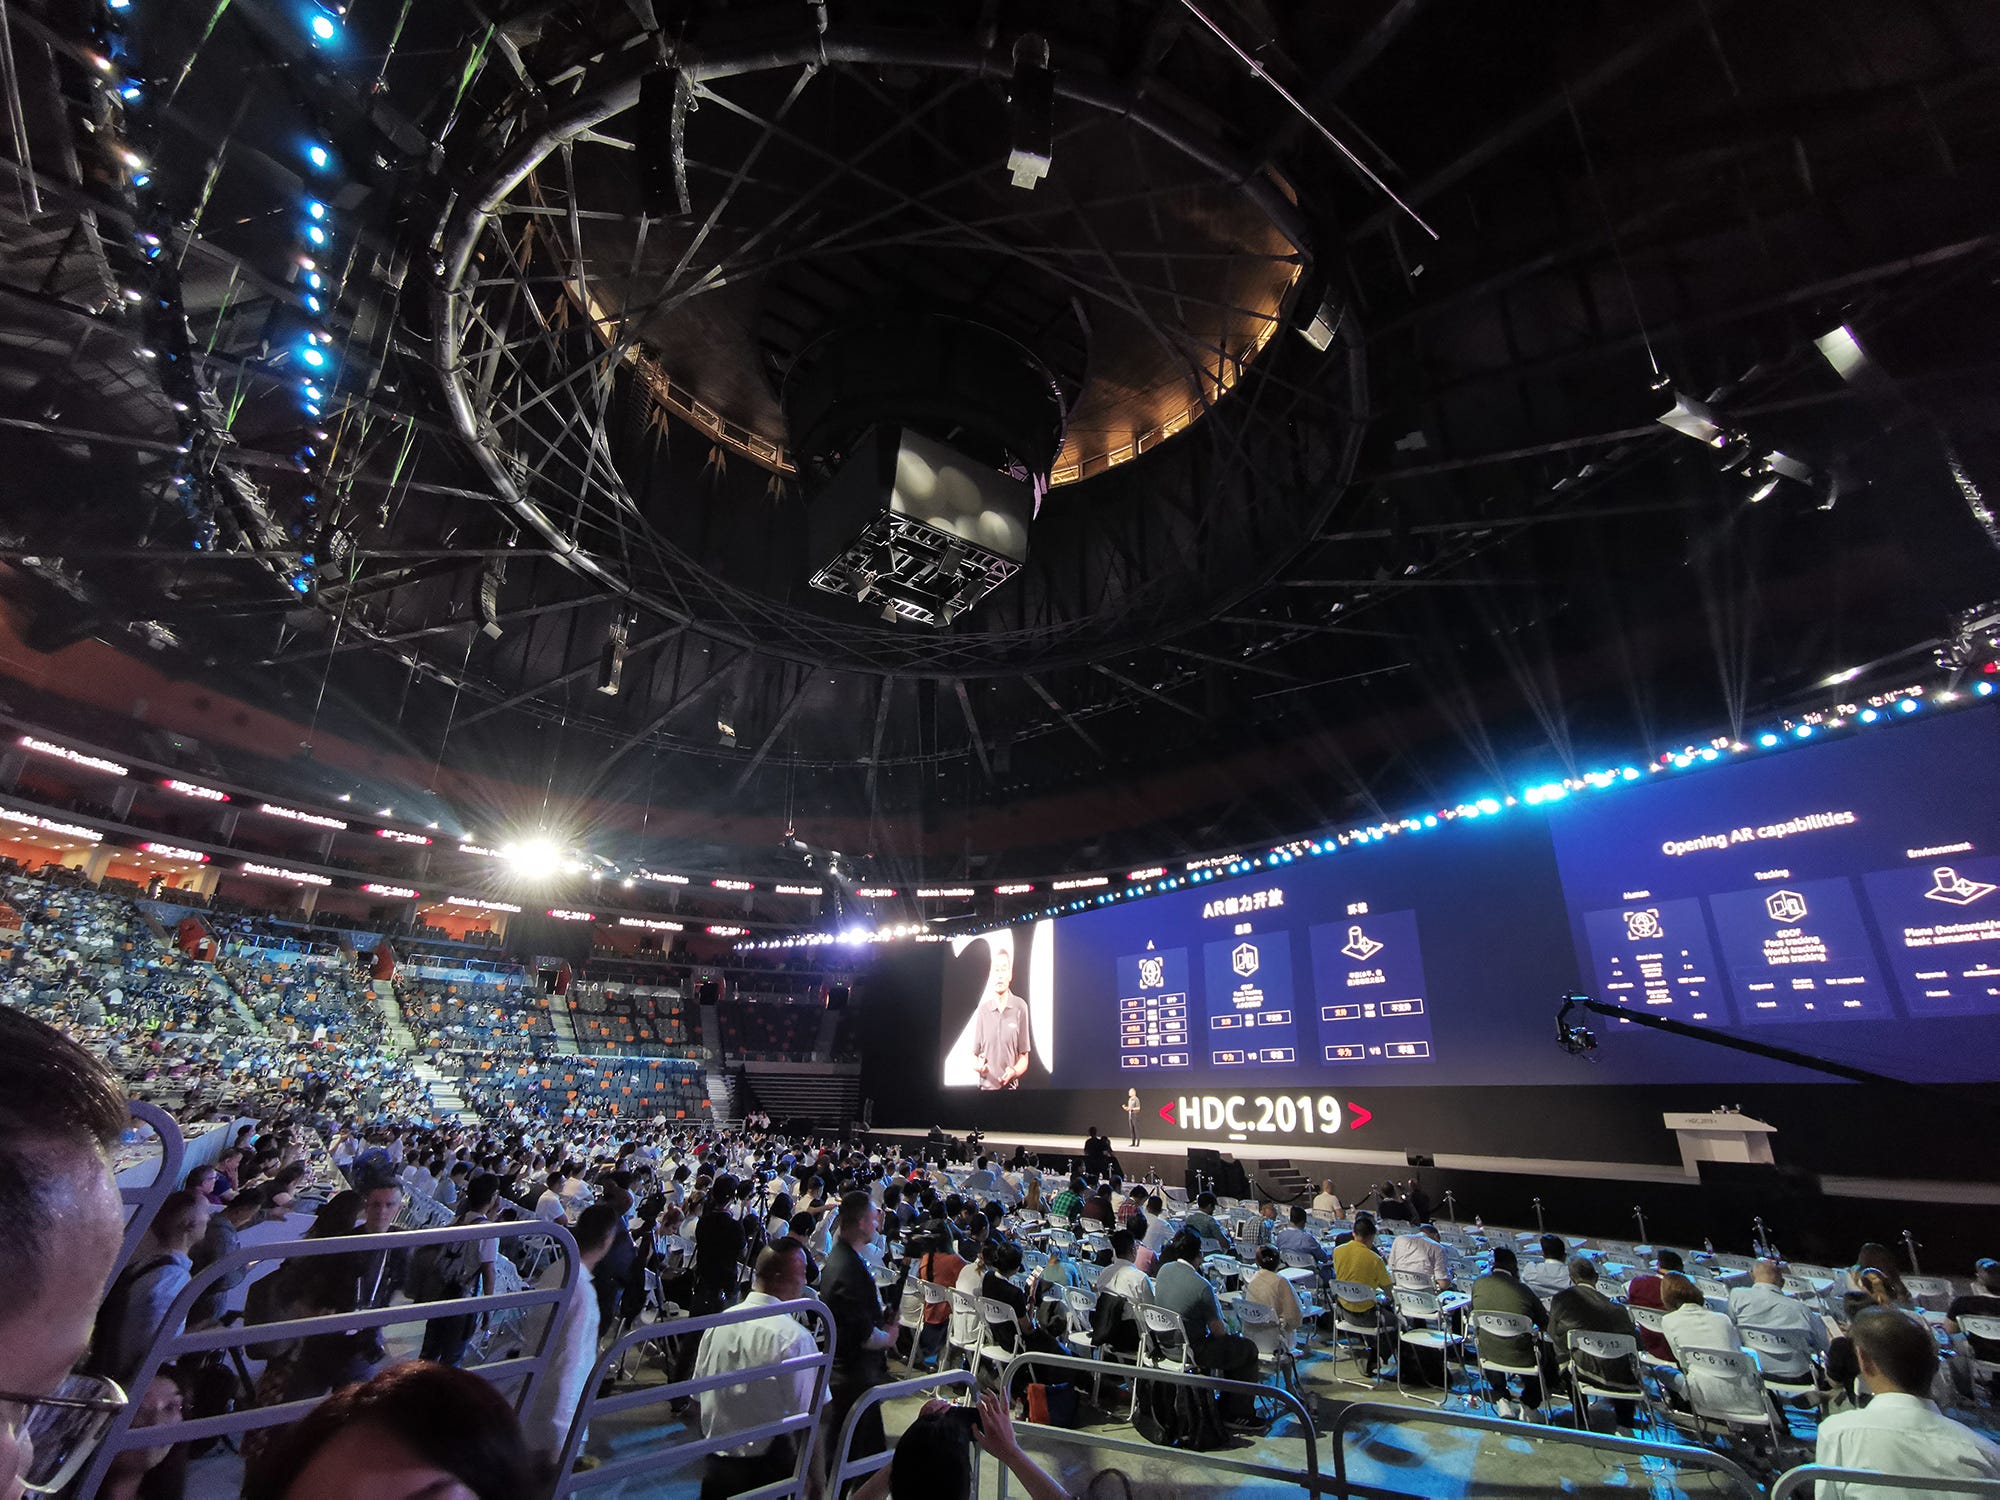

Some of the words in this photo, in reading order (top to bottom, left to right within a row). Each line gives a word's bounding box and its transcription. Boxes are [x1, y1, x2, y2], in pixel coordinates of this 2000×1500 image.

[1662, 832, 1728, 857] Opening
[1729, 826, 1756, 845] AR
[1756, 810, 1857, 839] capabilities
[1906, 841, 1974, 859] Environment
[1754, 869, 1790, 880] Tracking
